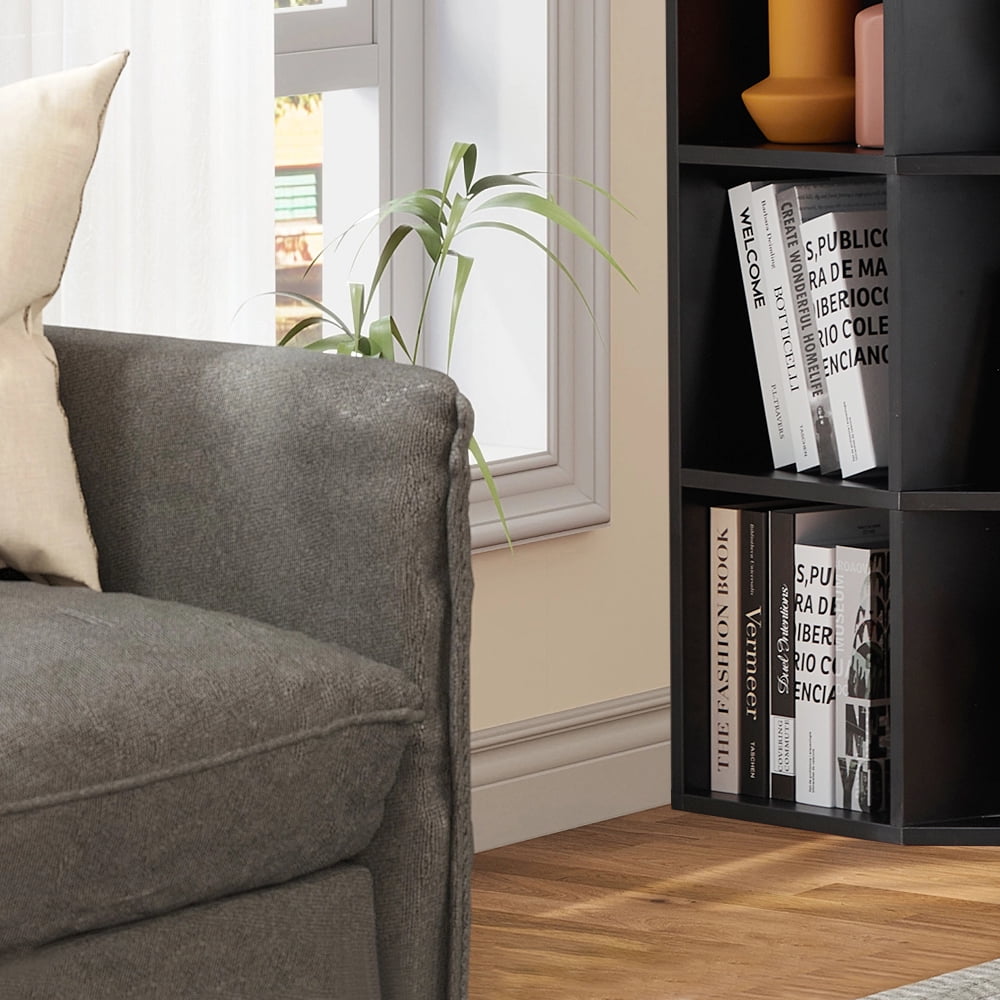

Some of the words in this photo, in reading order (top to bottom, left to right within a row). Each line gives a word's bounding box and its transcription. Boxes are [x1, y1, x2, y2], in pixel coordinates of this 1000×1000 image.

[740, 206, 766, 309] WELCOME
[781, 202, 799, 248] CREATE
[789, 250, 812, 330] WONDERFUL
[808, 267, 828, 291] RA
[830, 259, 853, 282] DE
[813, 286, 888, 319] IBERIOC
[774, 286, 799, 391] BOTTICELLI
[803, 333, 824, 398] HOMELIFE
[717, 528, 729, 595] BOOK
[796, 564, 836, 587] S,PU
[717, 604, 729, 713] FASHION
[745, 605, 762, 720] Vermeer
[717, 722, 729, 772] THE
[749, 741, 757, 779] TASCHEN
